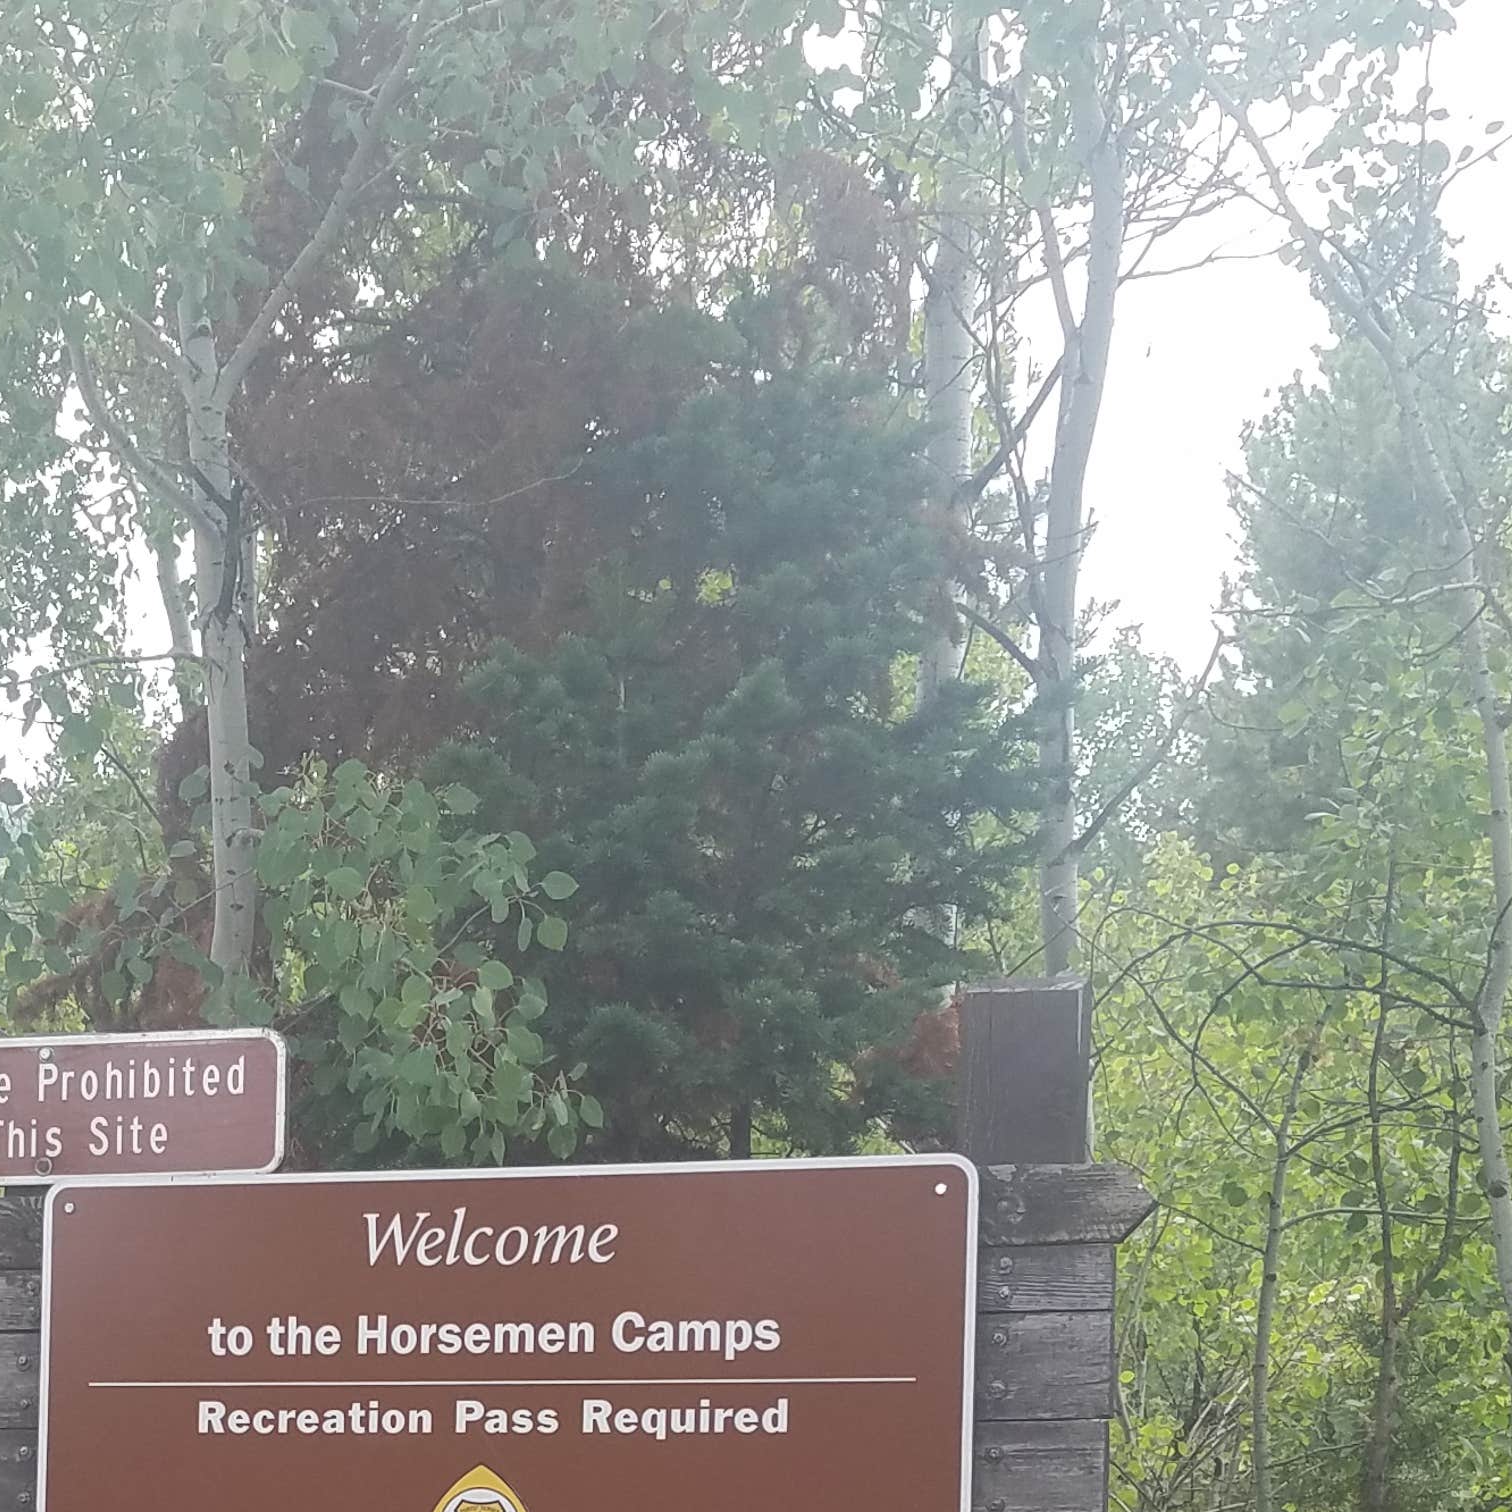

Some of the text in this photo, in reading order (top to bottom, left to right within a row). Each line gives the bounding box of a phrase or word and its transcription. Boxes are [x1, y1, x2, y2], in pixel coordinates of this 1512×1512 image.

[38, 1054, 246, 1102] Prohibited
[89, 1115, 169, 1156] Site
[363, 1206, 619, 1268] Welcome
[208, 1311, 782, 1362] to the Horsemen Camps
[198, 1398, 789, 1440] Recreation Pass Required
